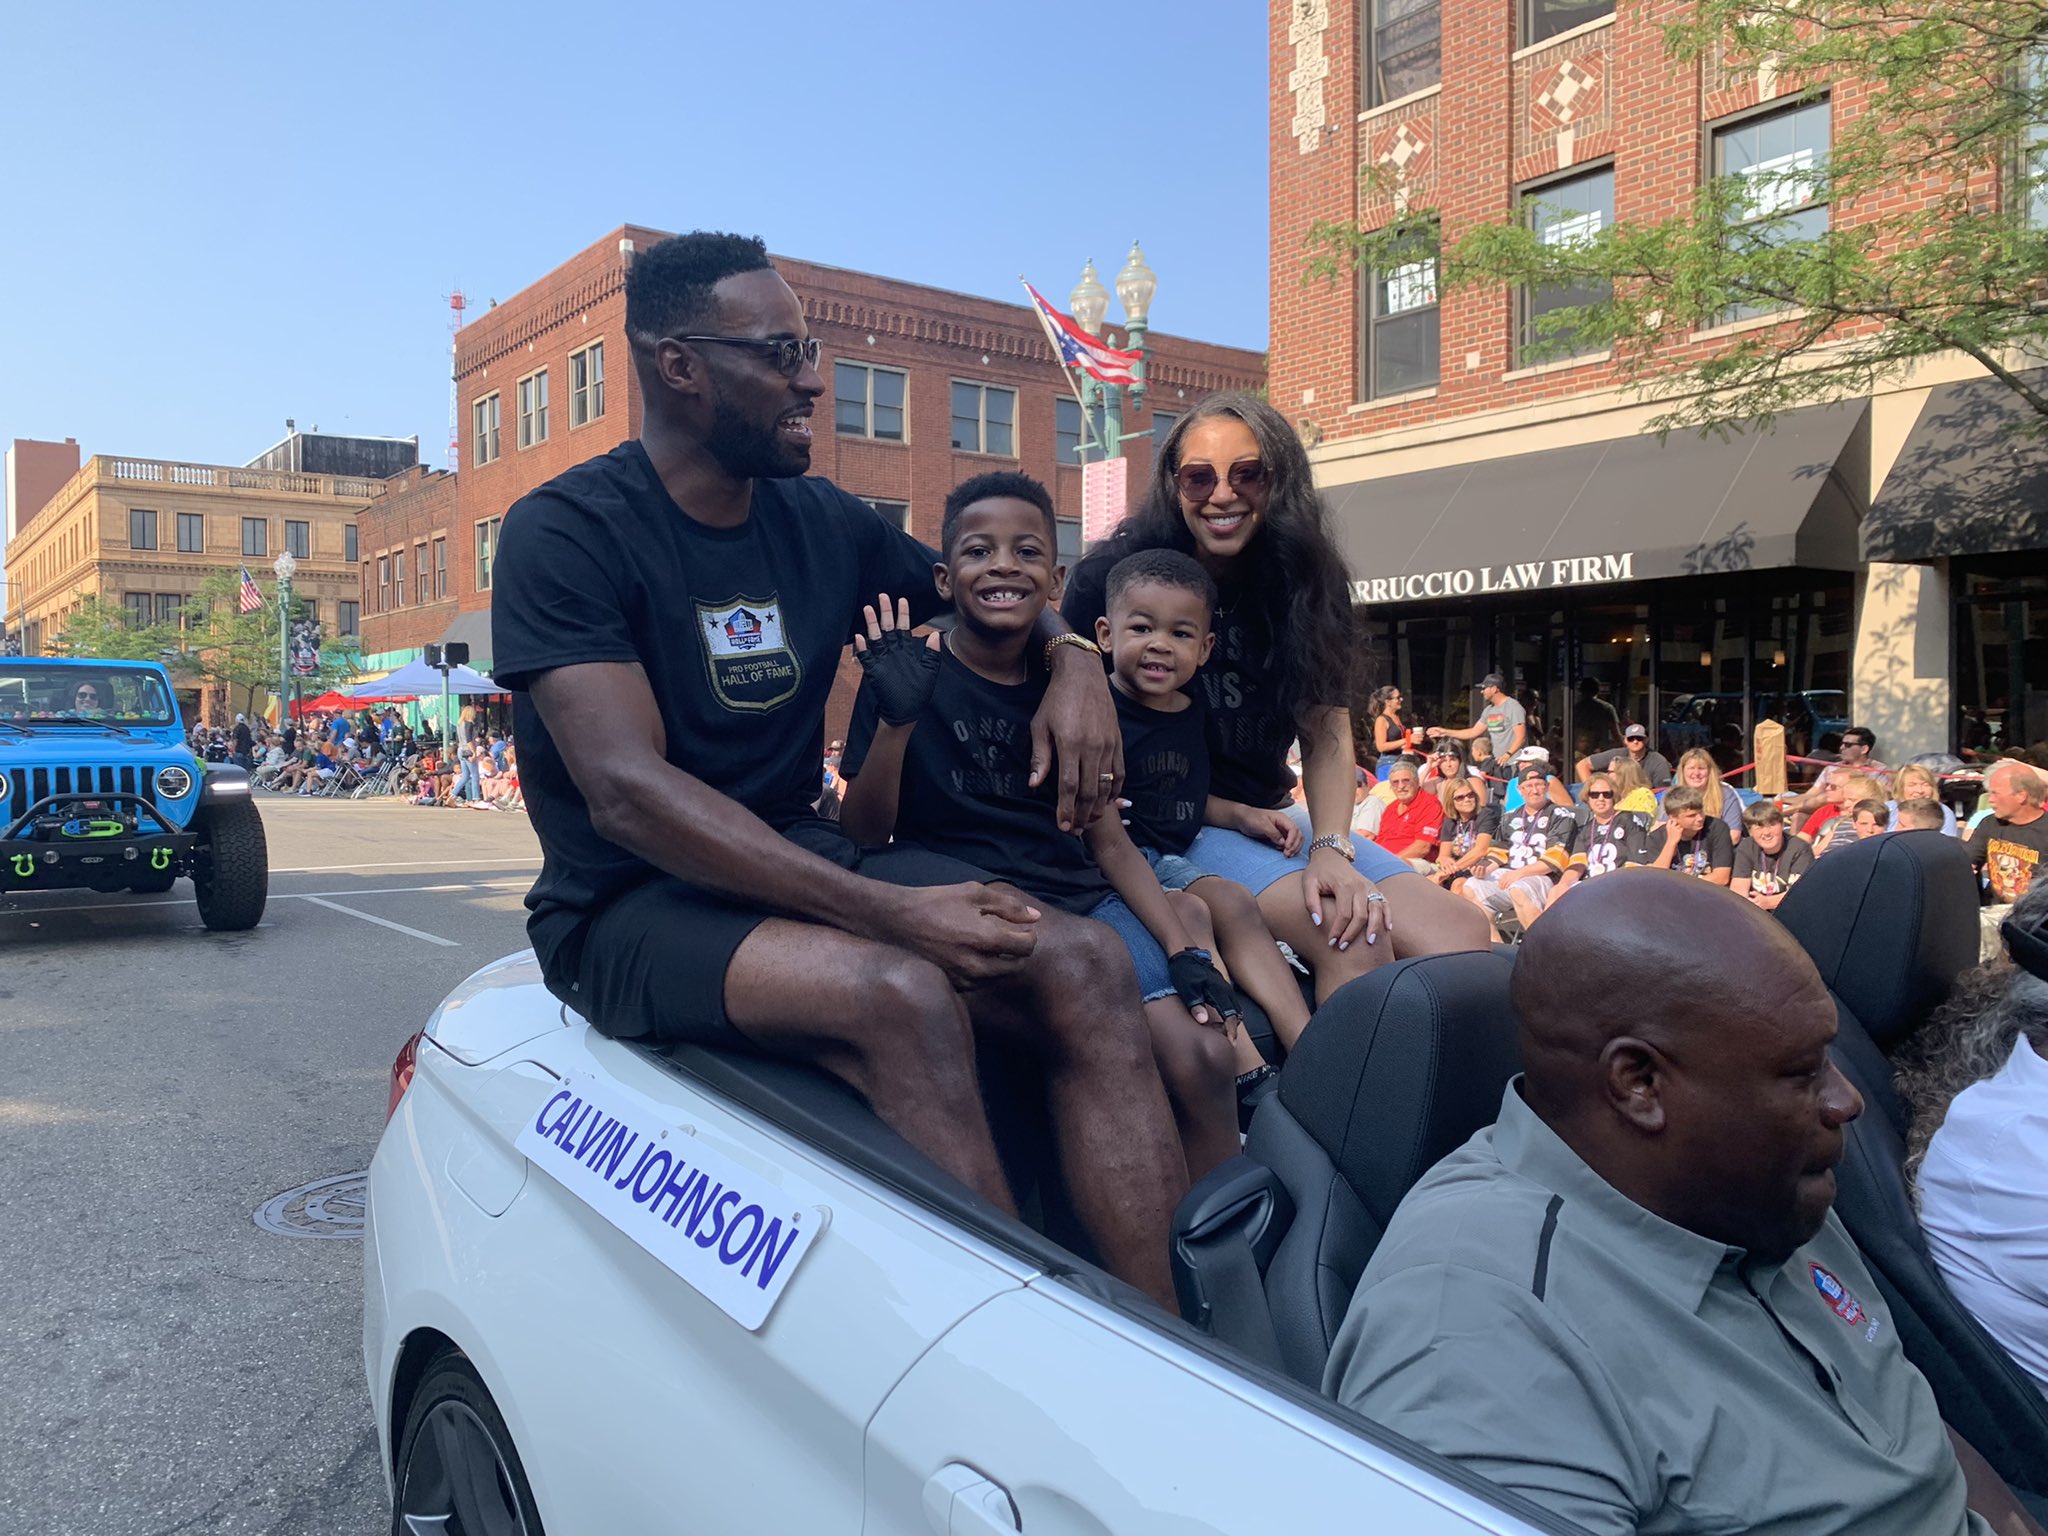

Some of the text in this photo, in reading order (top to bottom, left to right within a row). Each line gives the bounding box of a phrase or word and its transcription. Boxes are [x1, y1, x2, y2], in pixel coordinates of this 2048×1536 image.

[1350, 552, 1635, 602] RRUCCIO LAW FIRM
[721, 665, 794, 686] HALL OF FAME
[728, 661, 779, 674] PRO FOOTBALL
[1201, 671, 1243, 709] VS
[535, 1090, 800, 1291] CALVIN JOHNSON
